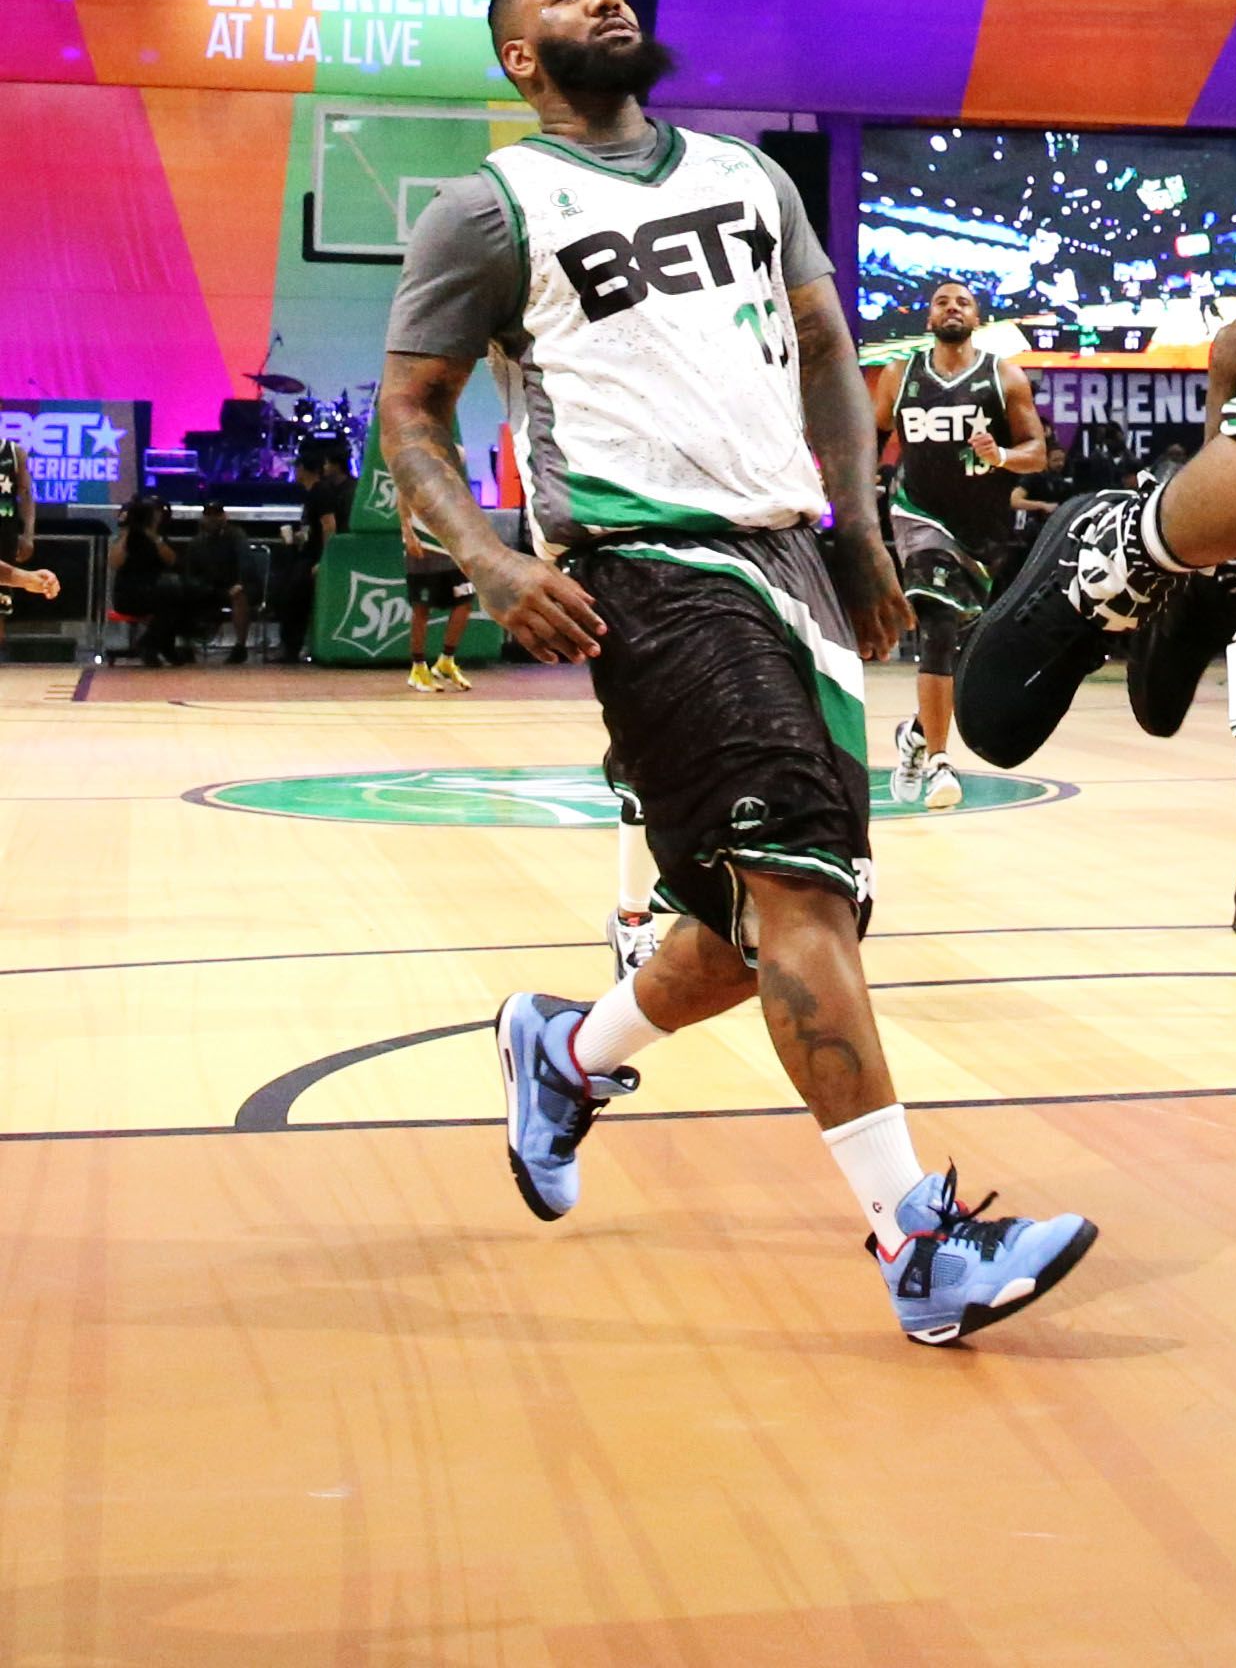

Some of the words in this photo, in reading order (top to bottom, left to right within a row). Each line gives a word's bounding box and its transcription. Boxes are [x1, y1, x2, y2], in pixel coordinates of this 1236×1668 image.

[206, 11, 253, 60] AT
[263, 13, 333, 64] L.A.
[342, 18, 424, 67] LIVE
[555, 200, 745, 324] BET
[900, 404, 977, 444] BET
[1034, 372, 1208, 424] ERIENC
[27, 456, 120, 482] ERIENCE
